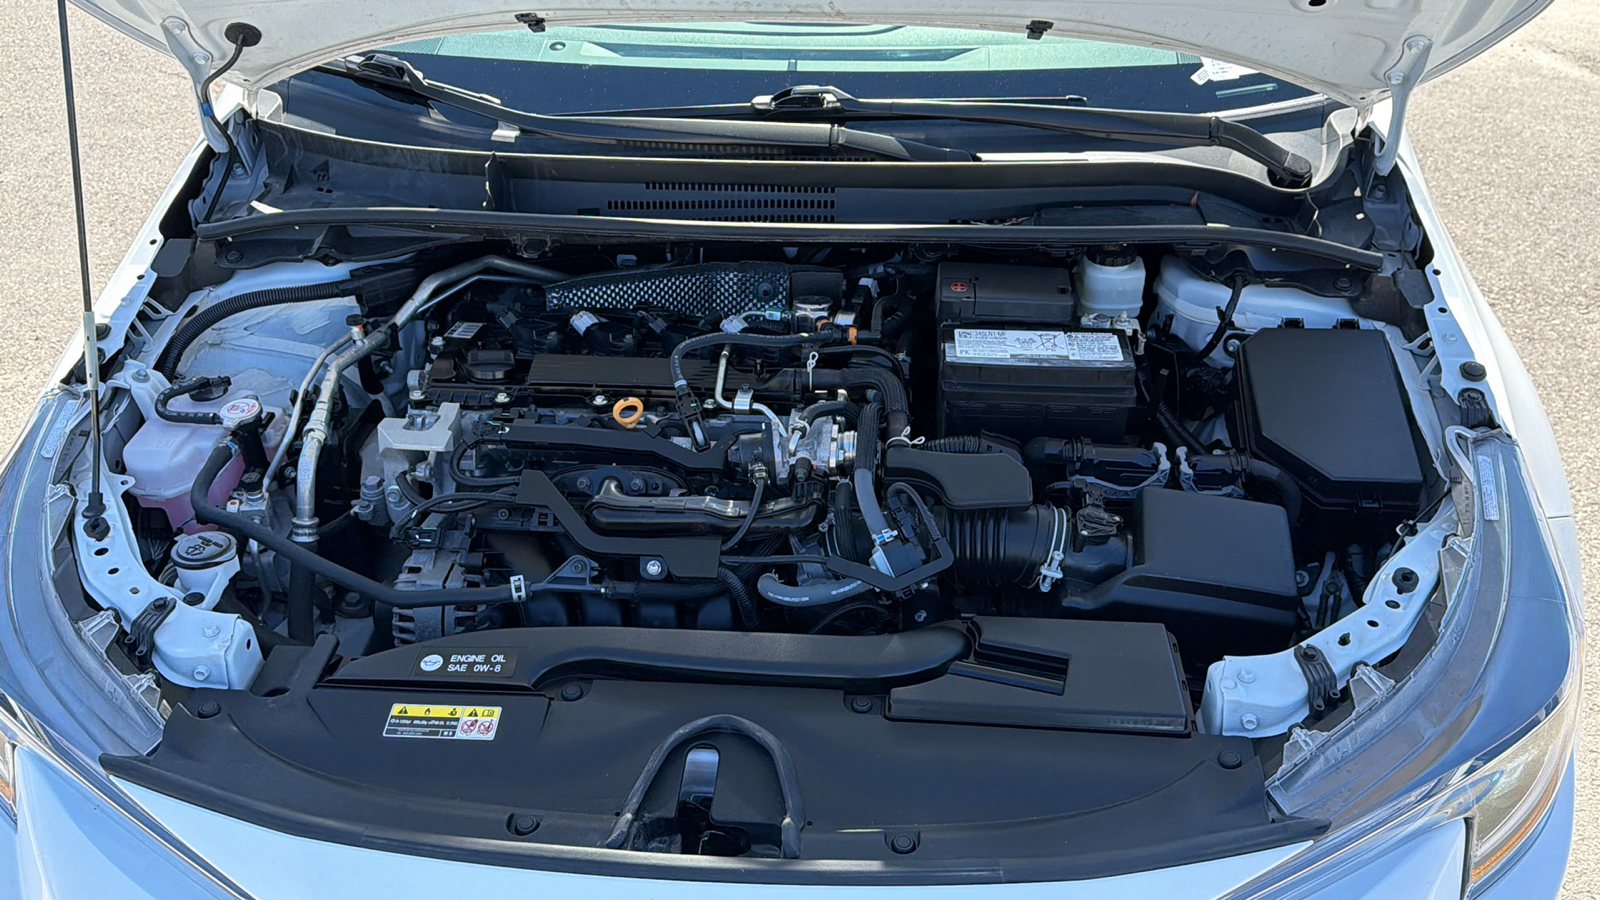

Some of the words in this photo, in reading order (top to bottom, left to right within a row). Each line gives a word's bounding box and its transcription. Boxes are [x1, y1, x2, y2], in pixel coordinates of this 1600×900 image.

[450, 654, 486, 663] ENGINE
[490, 654, 506, 663] OIL
[447, 664, 468, 672] SAE
